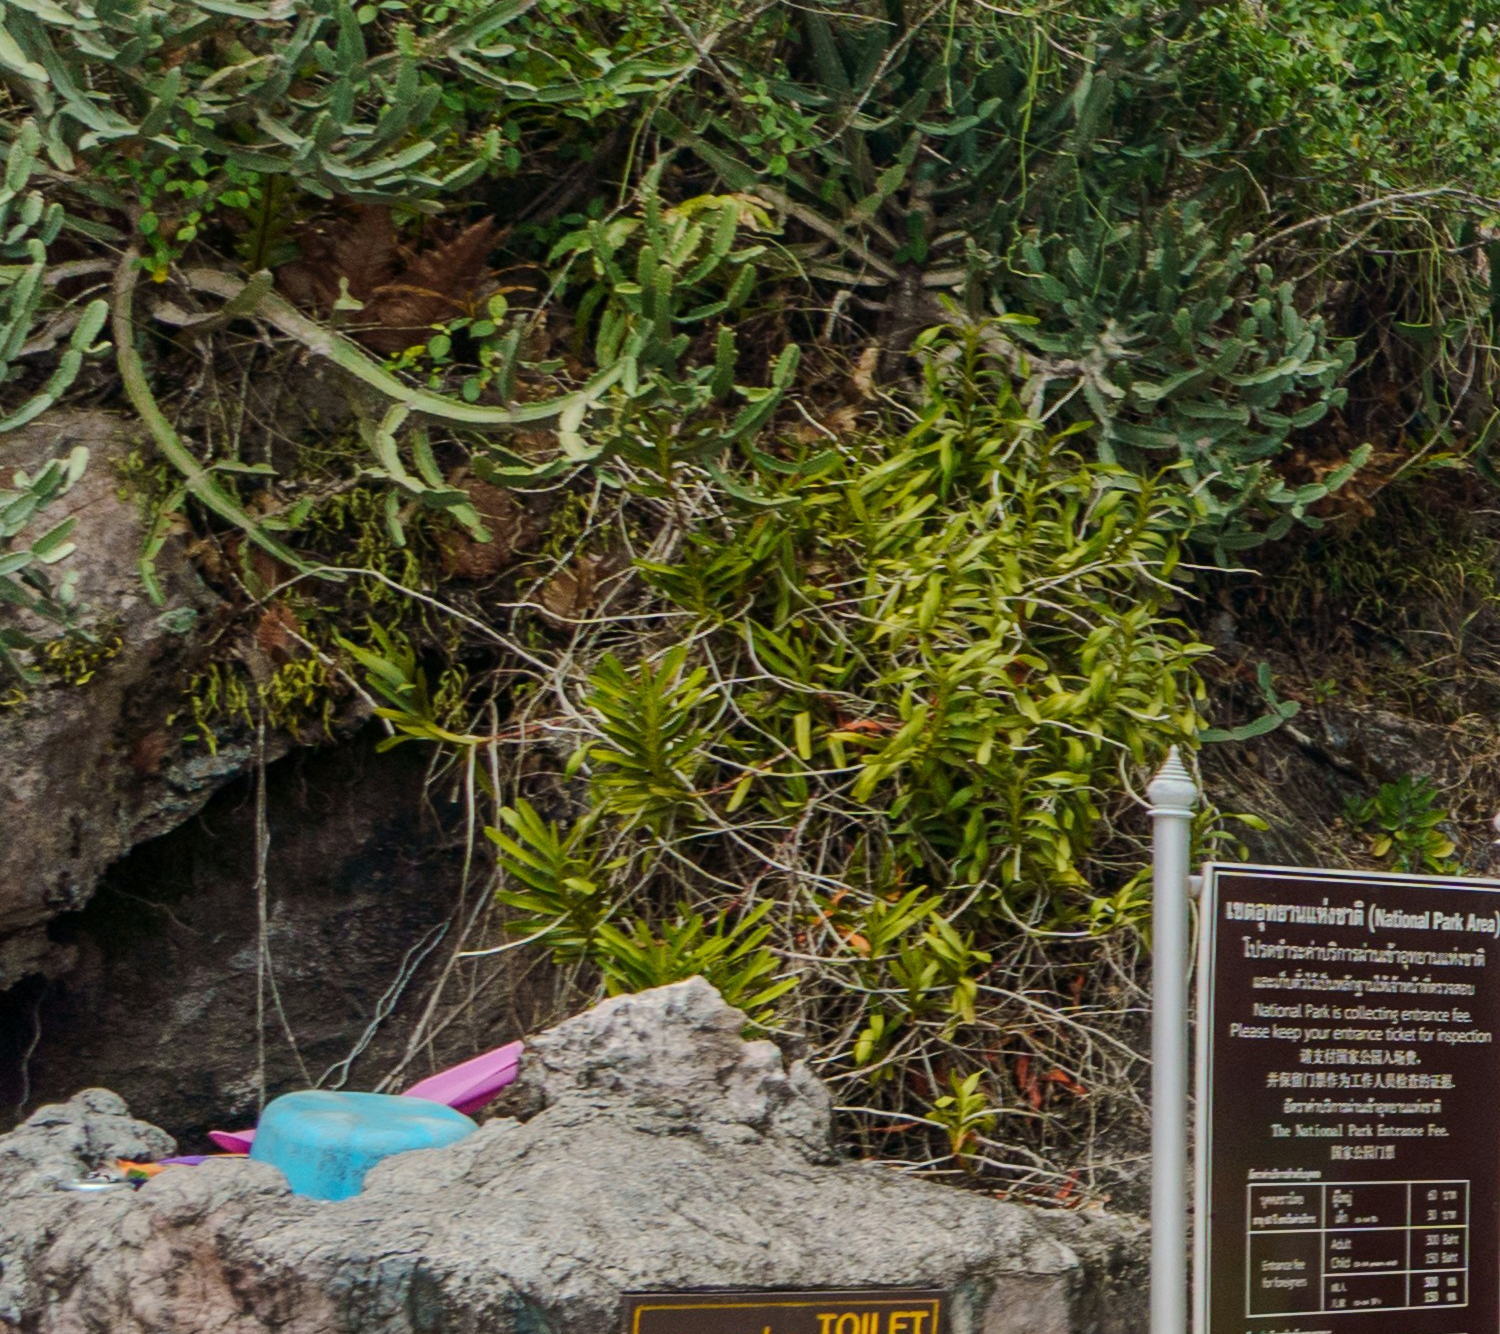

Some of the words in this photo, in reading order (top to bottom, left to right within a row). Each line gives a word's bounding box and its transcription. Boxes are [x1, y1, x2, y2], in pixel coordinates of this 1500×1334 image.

[1226, 897, 1364, 931] เขตอุทยานแห่งชาติ
[1369, 904, 1429, 933] (National
[1432, 913, 1463, 931] Park
[1466, 911, 1500, 939] Area)
[1253, 1003, 1302, 1019] National
[1304, 1003, 1330, 1019] Park
[1332, 1004, 1342, 1019] is
[1344, 1005, 1399, 1025] collecting
[1401, 1008, 1450, 1022] entrance
[1230, 1023, 1270, 1039] Please
[1272, 1024, 1301, 1042] keep
[1303, 1027, 1331, 1043] your
[1333, 1027, 1383, 1041] entrance
[1385, 1027, 1417, 1042] ticket
[1418, 1027, 1435, 1043] for
[1437, 1028, 1492, 1045] inspection
[1271, 1123, 1291, 1138] The
[1295, 1123, 1344, 1138] National
[1348, 1123, 1374, 1138] Park
[1377, 1124, 1425, 1138] Entrance
[1427, 1124, 1450, 1138] Fee.
